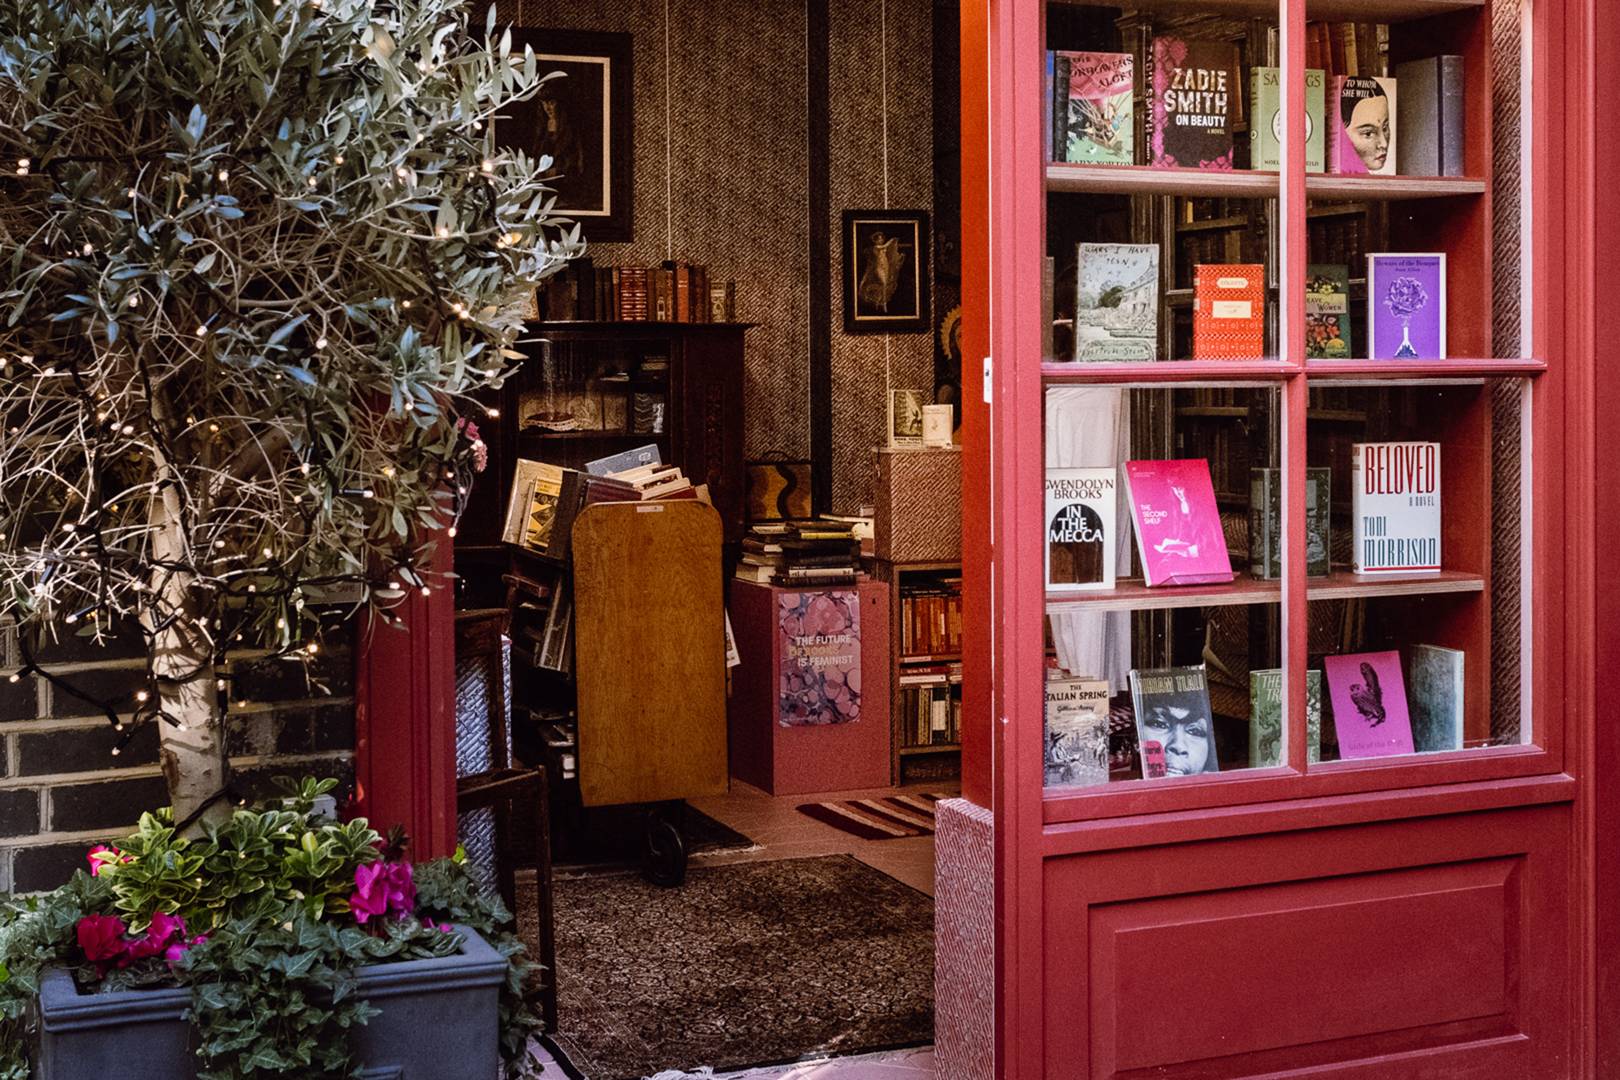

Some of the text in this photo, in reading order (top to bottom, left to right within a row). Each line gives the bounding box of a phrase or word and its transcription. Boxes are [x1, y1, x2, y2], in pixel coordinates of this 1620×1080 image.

[1171, 67, 1227, 91] ZADIE
[1346, 79, 1377, 89] TO WHOM
[1341, 89, 1370, 98] SHE WILL
[1163, 89, 1228, 114] SMITH
[1175, 114, 1225, 127] ON BEAUTY
[1366, 445, 1435, 495] BELOVED
[1054, 489, 1102, 500] BROOKS
[1415, 496, 1435, 507] NOVEL
[1066, 506, 1081, 518] IN
[1058, 517, 1087, 531] THE
[1144, 517, 1160, 525] SHELF
[1363, 516, 1387, 537] TONI
[1050, 529, 1104, 543] MECCA
[1364, 538, 1437, 567] MORRISON
[795, 634, 852, 647] THE FUTURE
[797, 655, 853, 668] IS FEMINIST
[1262, 675, 1281, 689] THE
[1047, 690, 1108, 701] TALIAN SPRING
